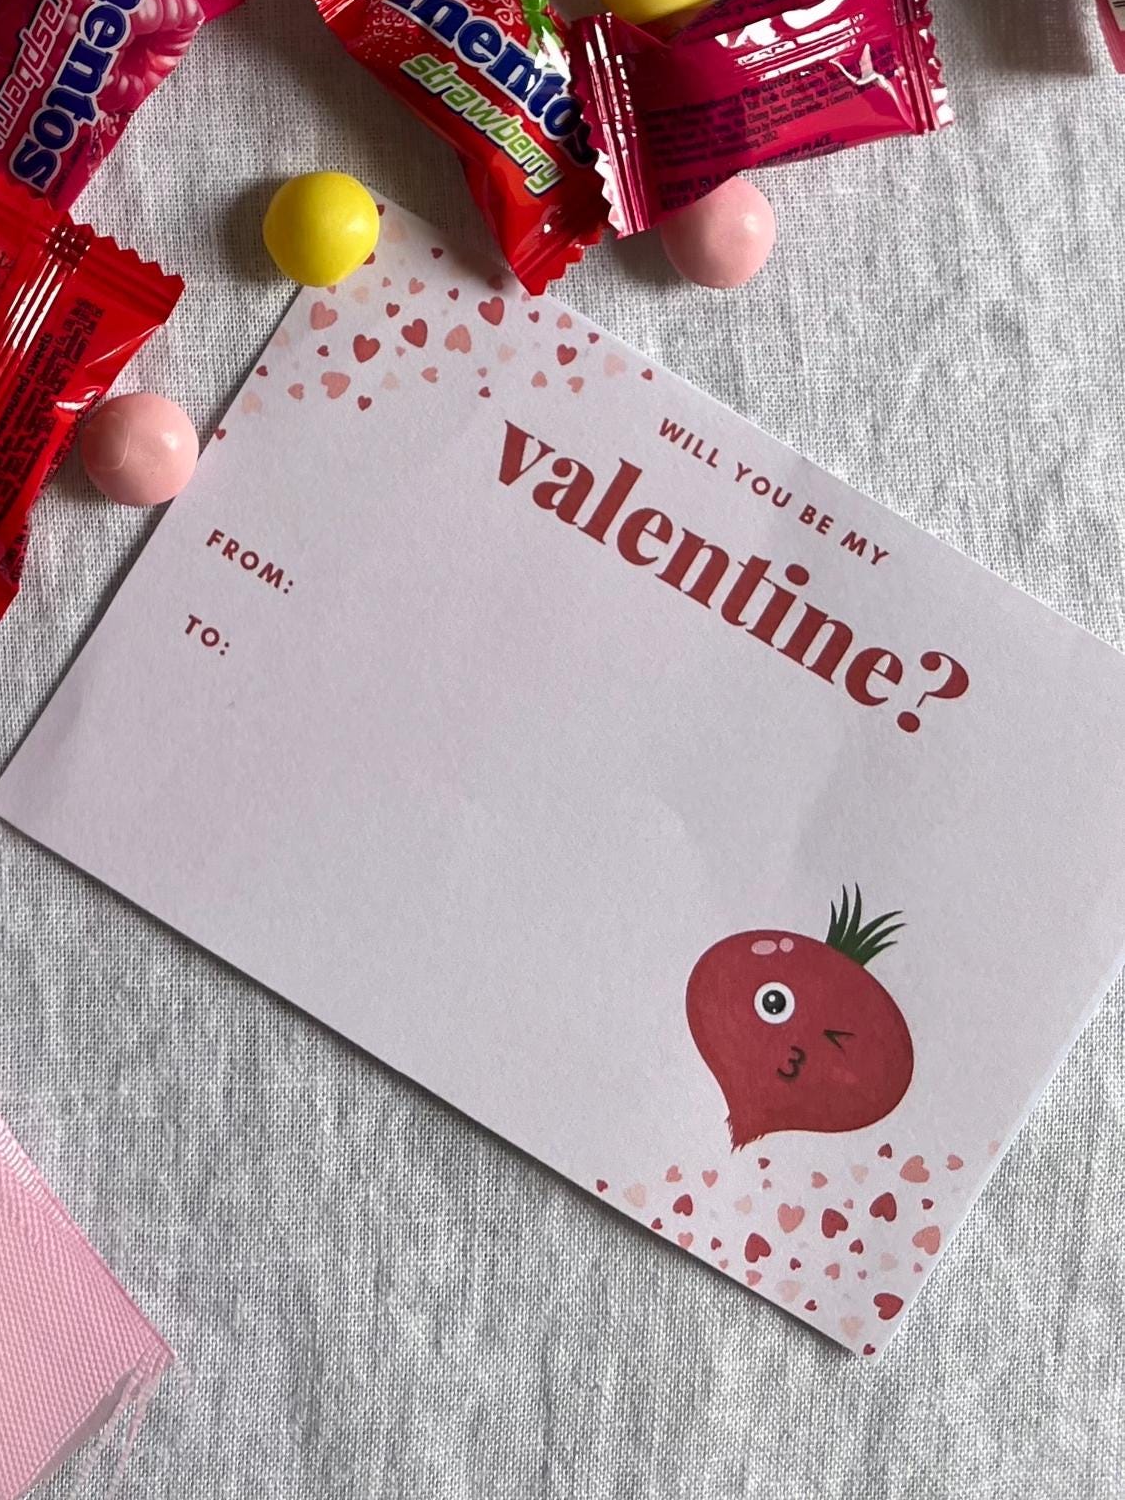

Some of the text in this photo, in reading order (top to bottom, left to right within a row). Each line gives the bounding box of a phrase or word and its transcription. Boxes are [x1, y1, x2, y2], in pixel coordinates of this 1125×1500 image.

[400, 53, 564, 197] strawberry
[206, 529, 295, 594] FROM:
[658, 418, 889, 566] WILL YOU BE MY
[183, 614, 231, 655] TO:
[498, 420, 970, 735] valentine?
